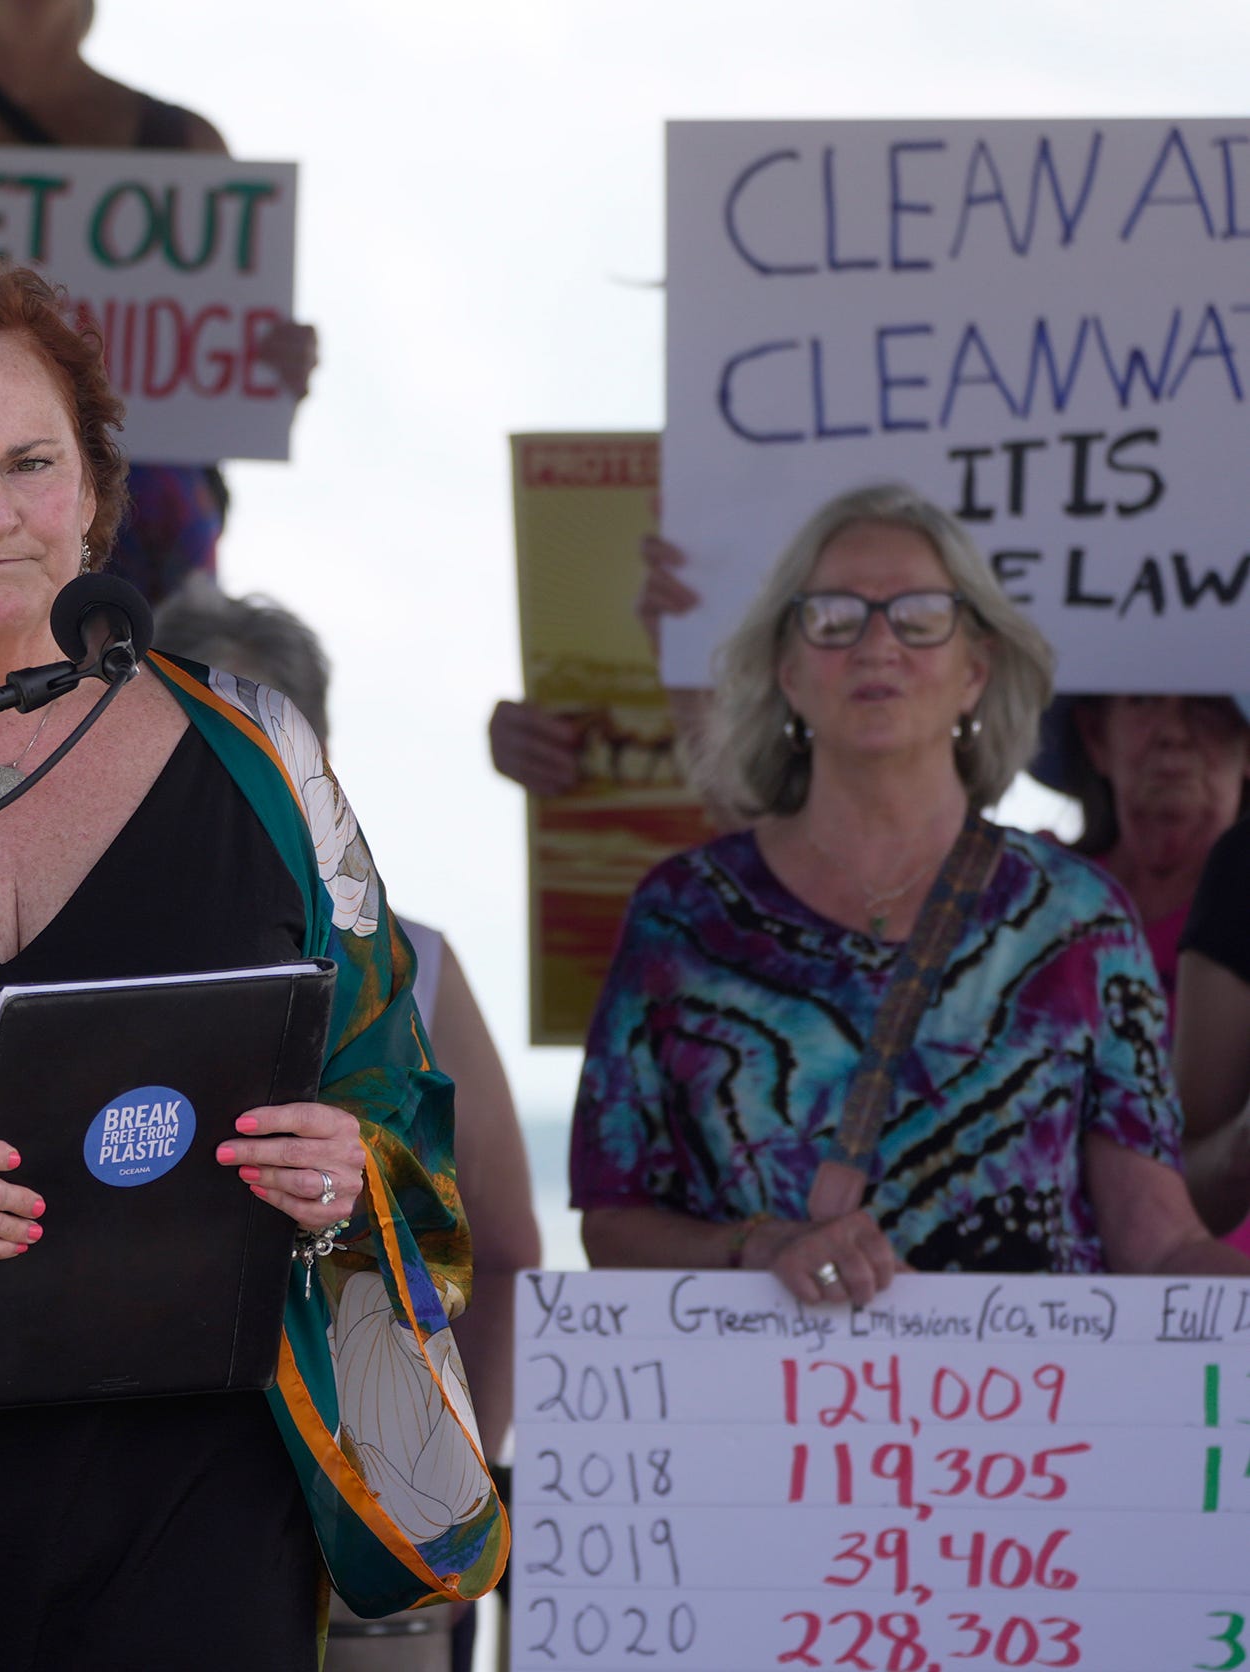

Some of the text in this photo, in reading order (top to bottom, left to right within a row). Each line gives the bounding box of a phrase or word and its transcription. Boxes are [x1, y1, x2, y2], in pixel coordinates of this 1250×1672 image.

[88, 180, 279, 274] OUT
[724, 129, 1103, 277] CLEAN
[1062, 547, 1250, 619] LAW
[98, 1137, 177, 1166] PLASTIC
[101, 1123, 180, 1146] FREE FROM
[103, 1100, 182, 1132] BREAK
[118, 1166, 151, 1176] OCEANA
[526, 1274, 629, 1339] Year
[1154, 1283, 1225, 1342] Full
[528, 1353, 668, 1423] 2017
[780, 1353, 1066, 1438] 124,009
[536, 1449, 673, 1500] 2018
[788, 1442, 1093, 1521] 119,305
[525, 1518, 1080, 1606] 2019 39,406
[525, 1598, 697, 1660] 2020
[775, 1609, 1082, 1672] 228,303
